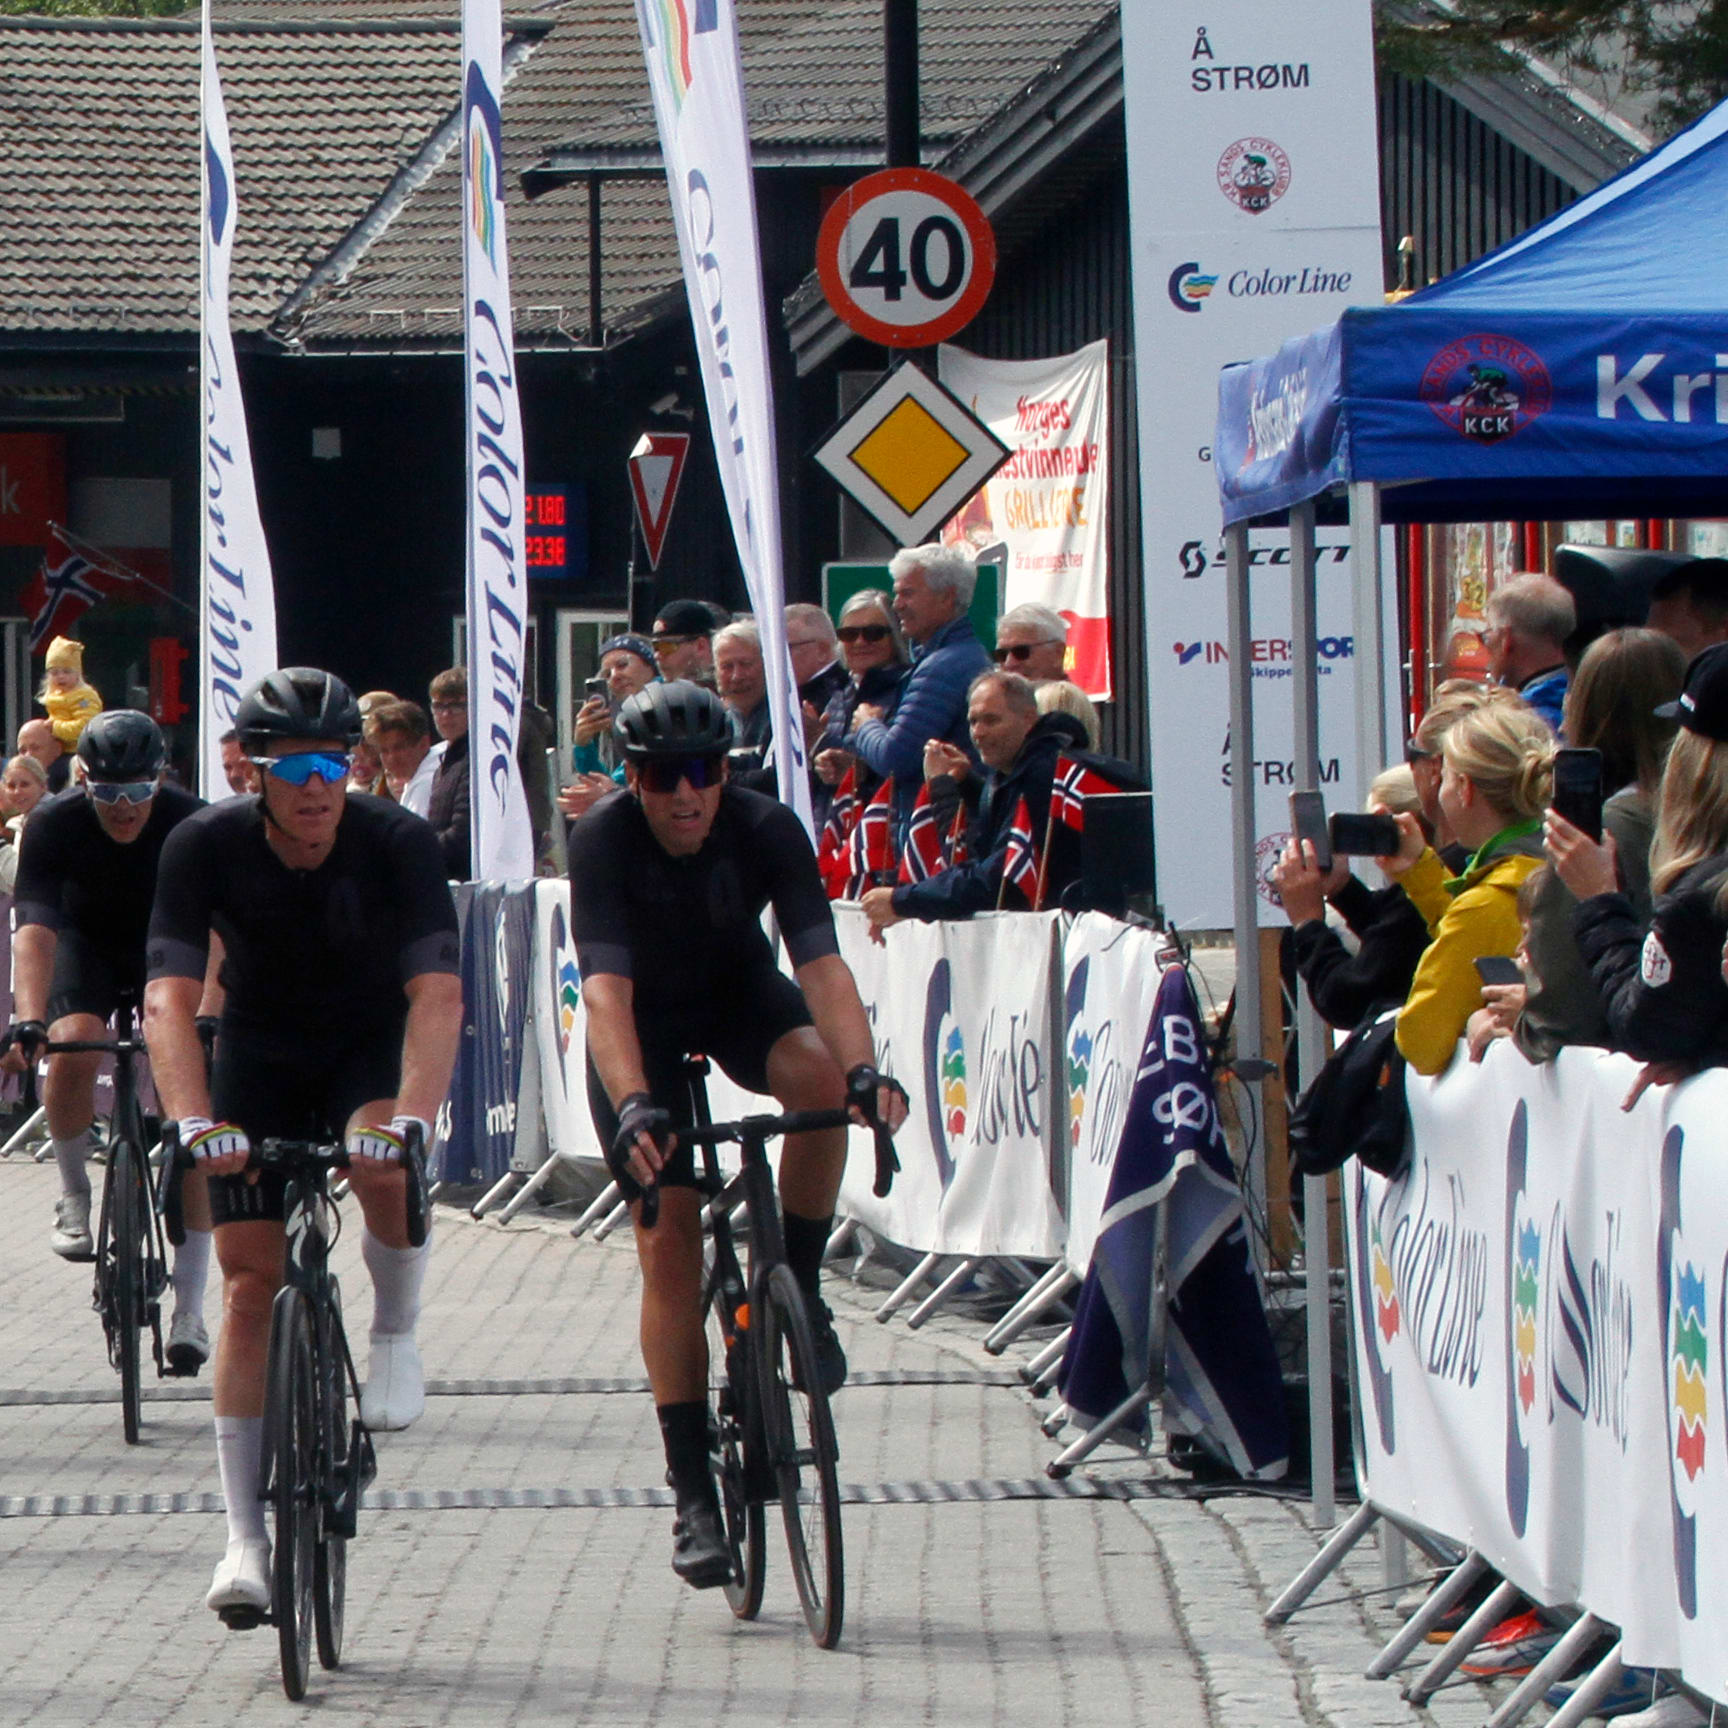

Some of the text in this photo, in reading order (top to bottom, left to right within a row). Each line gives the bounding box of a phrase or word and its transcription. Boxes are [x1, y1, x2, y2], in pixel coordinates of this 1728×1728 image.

[1191, 26, 1214, 61] Å
[1191, 63, 1309, 92] STRØM
[849, 214, 966, 302] 40
[1464, 415, 1510, 435] KCK
